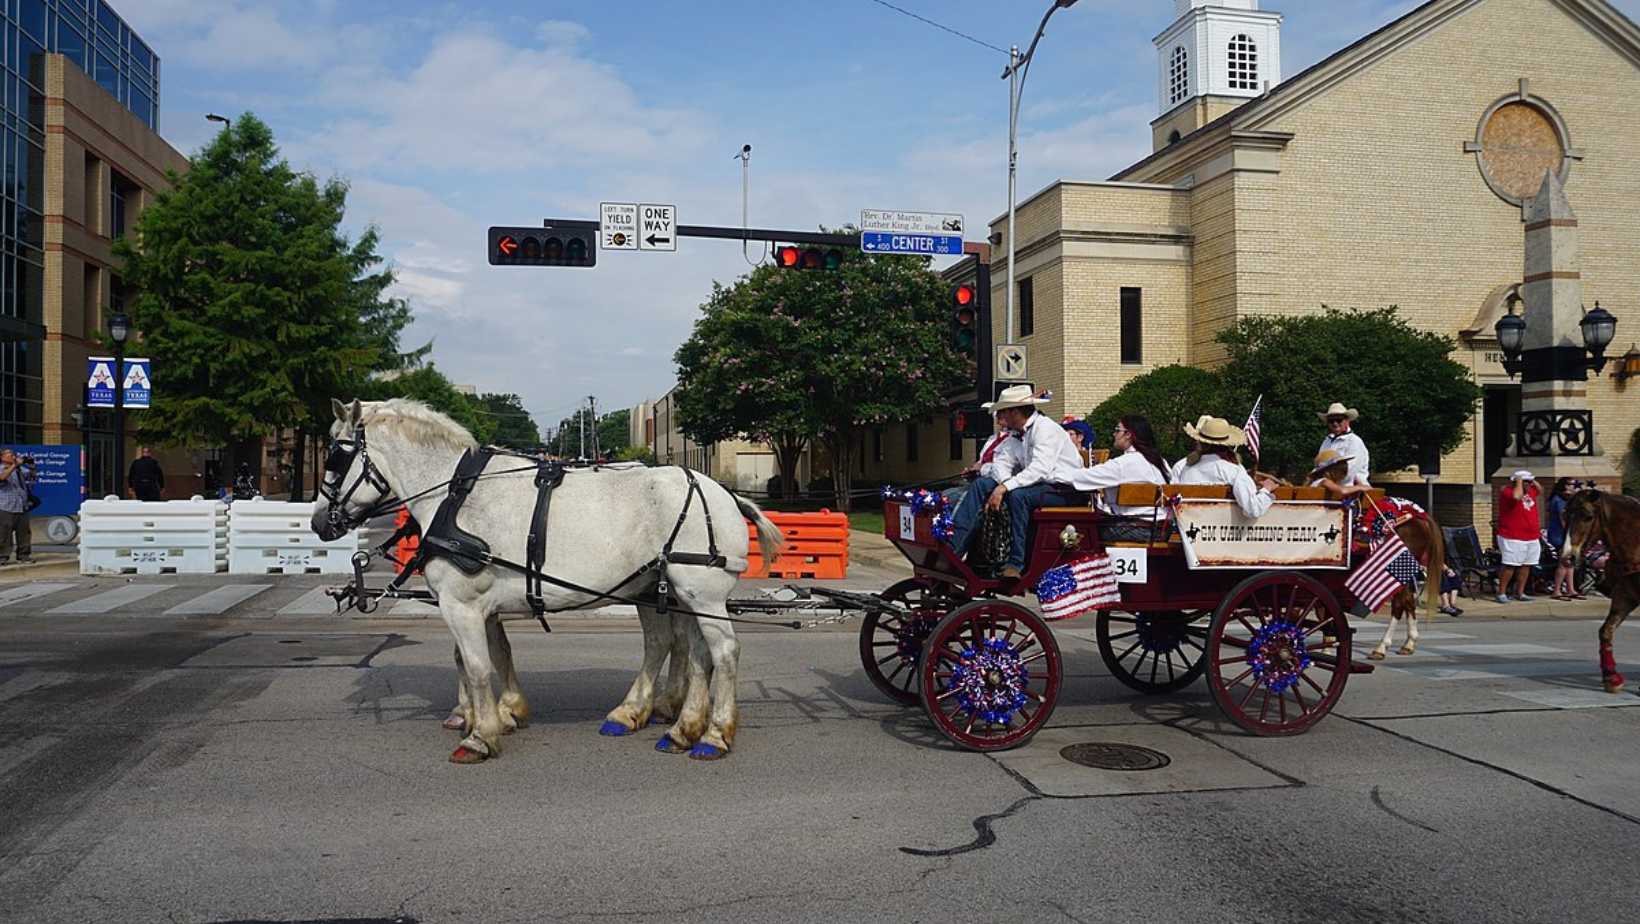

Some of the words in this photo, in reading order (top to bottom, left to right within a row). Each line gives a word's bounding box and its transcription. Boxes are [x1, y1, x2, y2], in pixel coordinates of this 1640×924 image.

[607, 214, 632, 224] YIELD
[645, 208, 669, 219] ONE
[864, 212, 881, 220] Rev.
[883, 213, 895, 221] Dr.
[897, 214, 923, 222] Martin
[644, 221, 670, 231] WAY
[864, 220, 890, 229] Luther
[892, 221, 909, 230] King
[877, 243, 891, 251] 400
[892, 236, 935, 251] CENTER
[53, 522, 68, 536] A
[903, 516, 911, 533] 34
[1201, 526, 1216, 541] GM
[1220, 526, 1244, 541] UAW
[1246, 526, 1283, 541] RIDING
[1286, 527, 1317, 542] TEAM
[1115, 559, 1138, 576] 34
